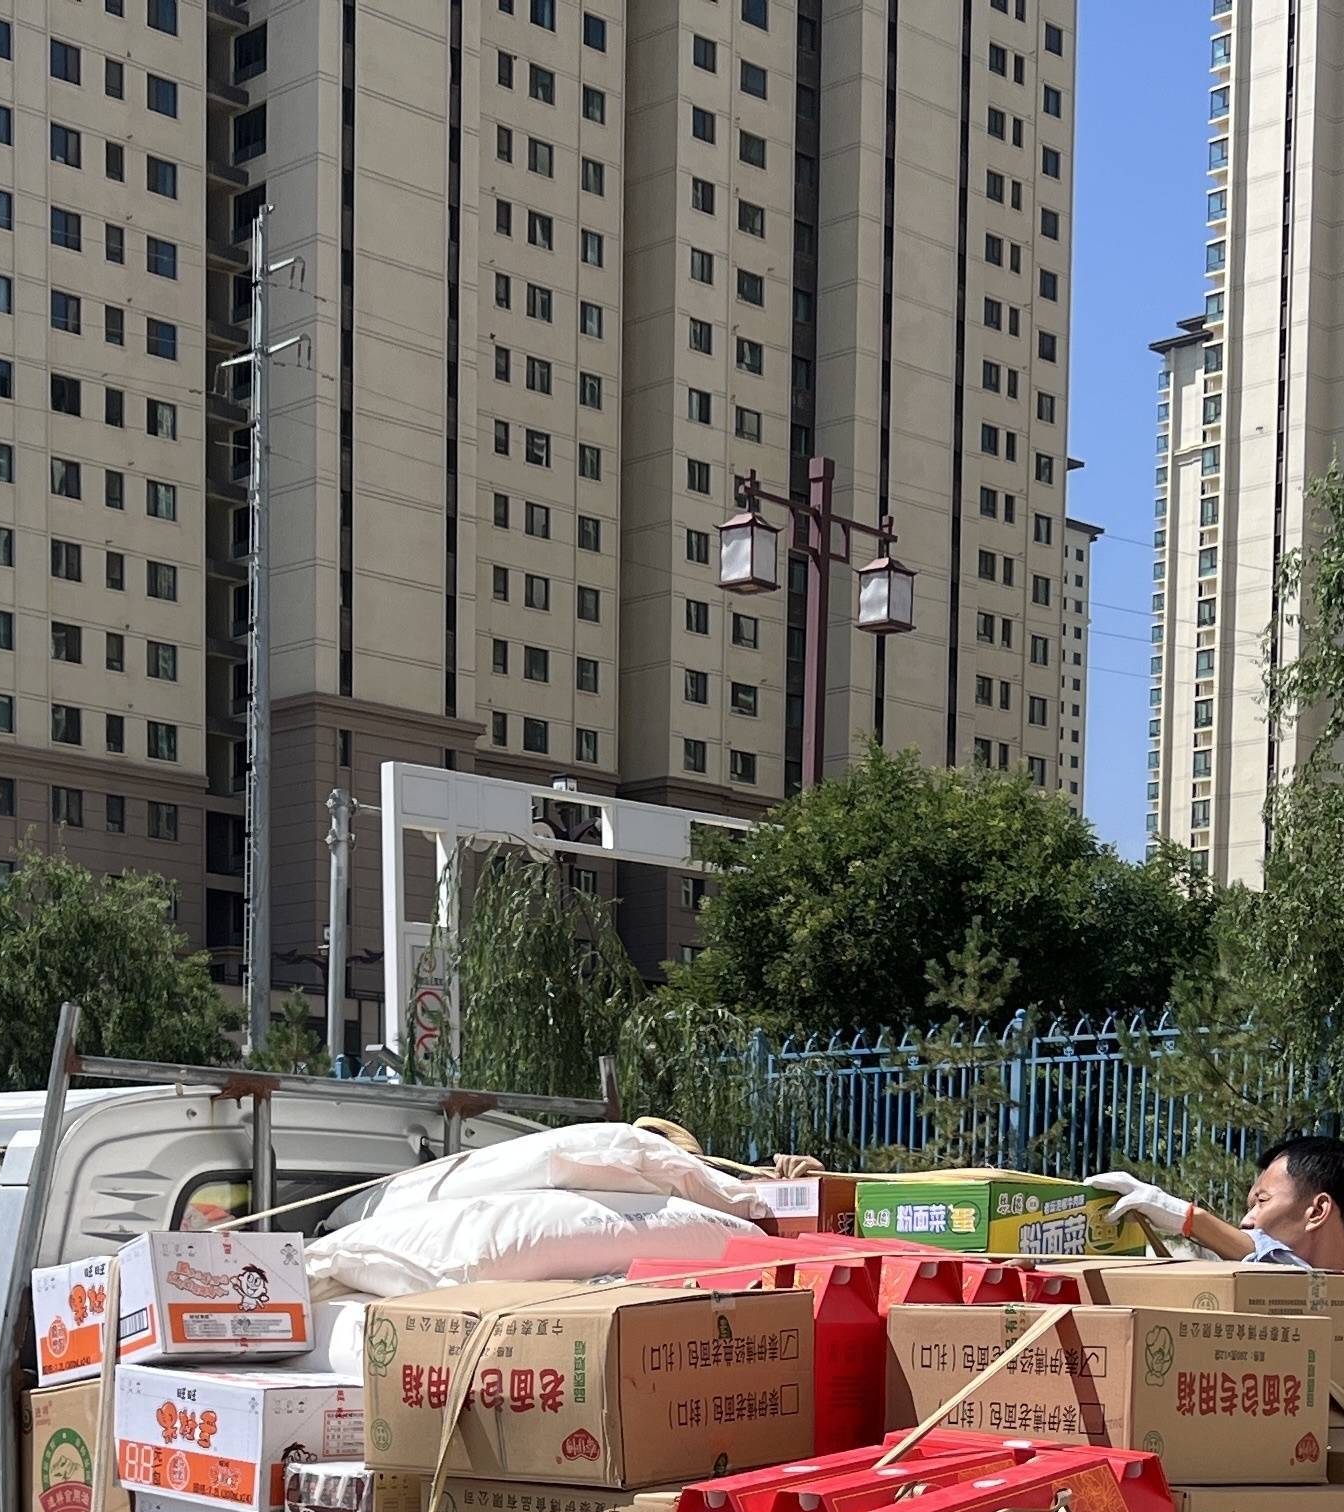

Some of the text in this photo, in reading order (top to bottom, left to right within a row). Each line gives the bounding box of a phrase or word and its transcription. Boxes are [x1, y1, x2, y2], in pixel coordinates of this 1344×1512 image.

[1176, 1371, 1302, 1417] 老面包专用箱
